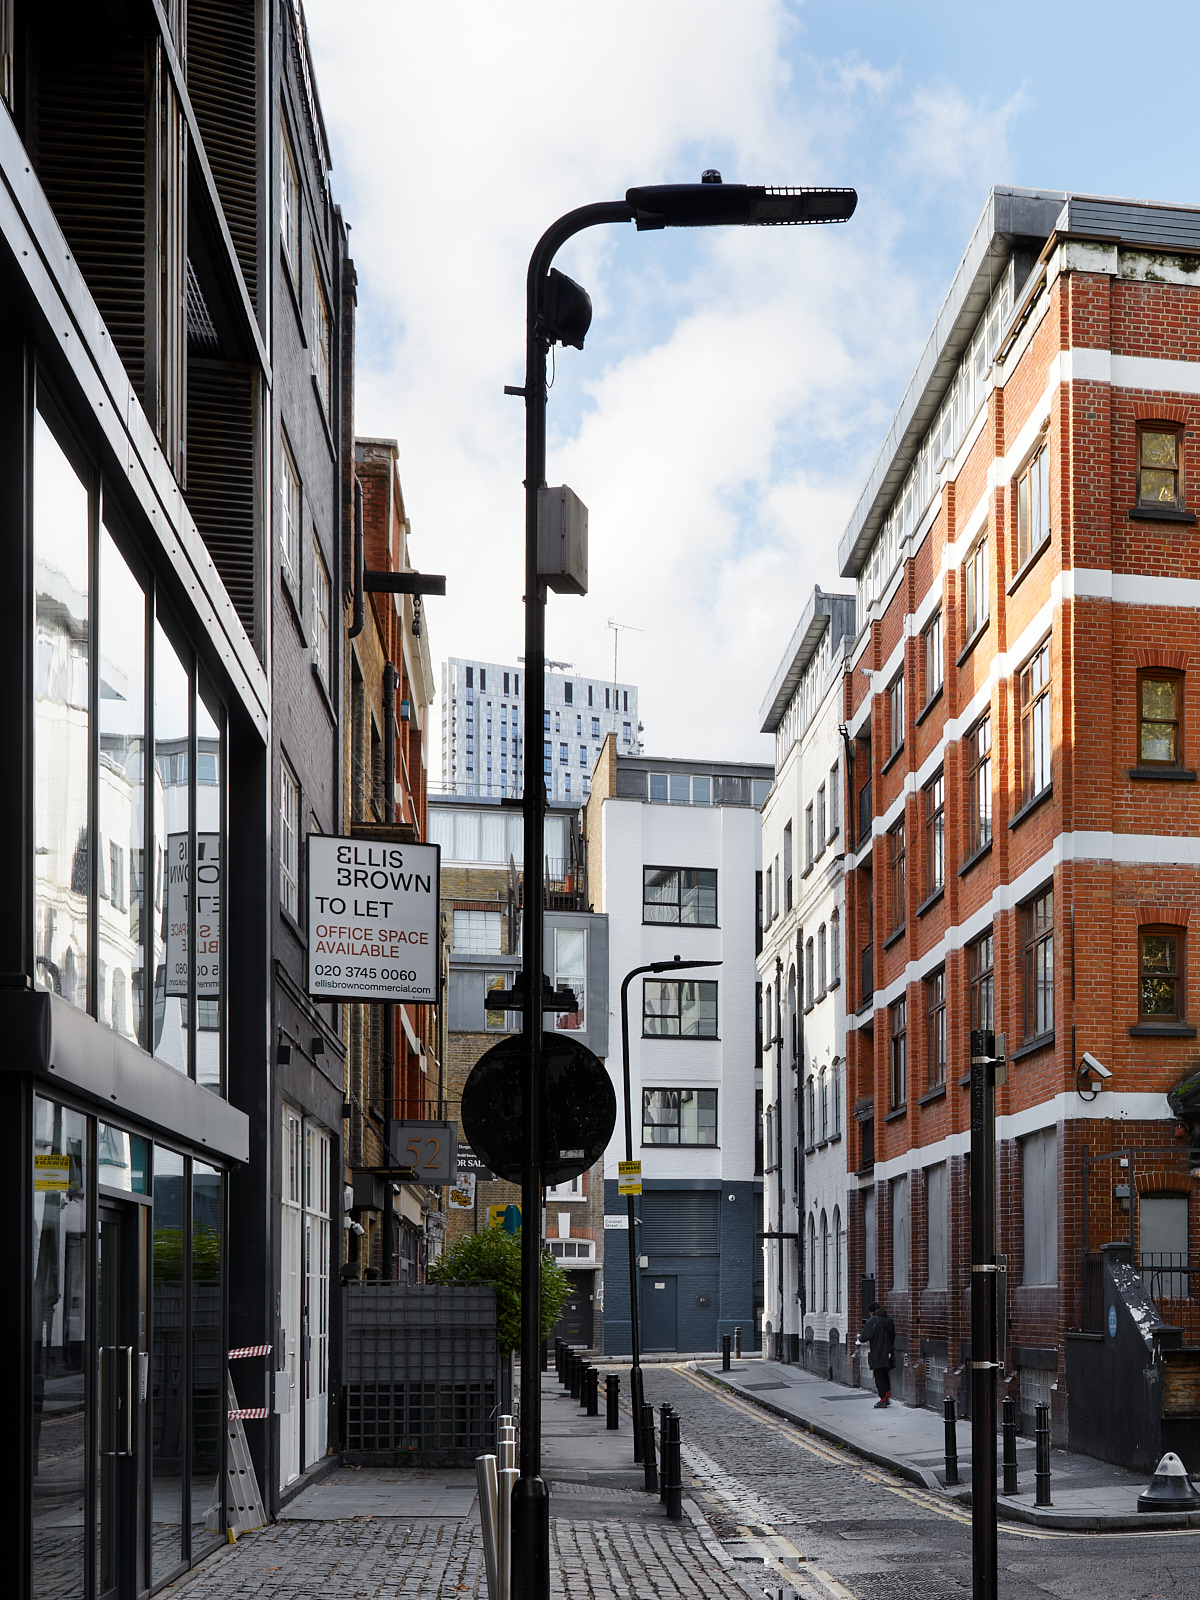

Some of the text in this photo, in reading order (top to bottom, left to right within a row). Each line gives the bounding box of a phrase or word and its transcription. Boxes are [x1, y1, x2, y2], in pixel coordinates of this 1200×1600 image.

[337, 845, 404, 869] ELLIS
[337, 867, 431, 893] BROWN
[315, 896, 394, 919] TO LET
[316, 925, 429, 945] OFFICE SPACE
[315, 940, 400, 958] AVAILABLE
[315, 964, 417, 981] 020 3745 0060
[315, 979, 431, 994] ellisbrowncommercial.com
[406, 1137, 440, 1169] 52
[467, 1159, 486, 1168] SAL
